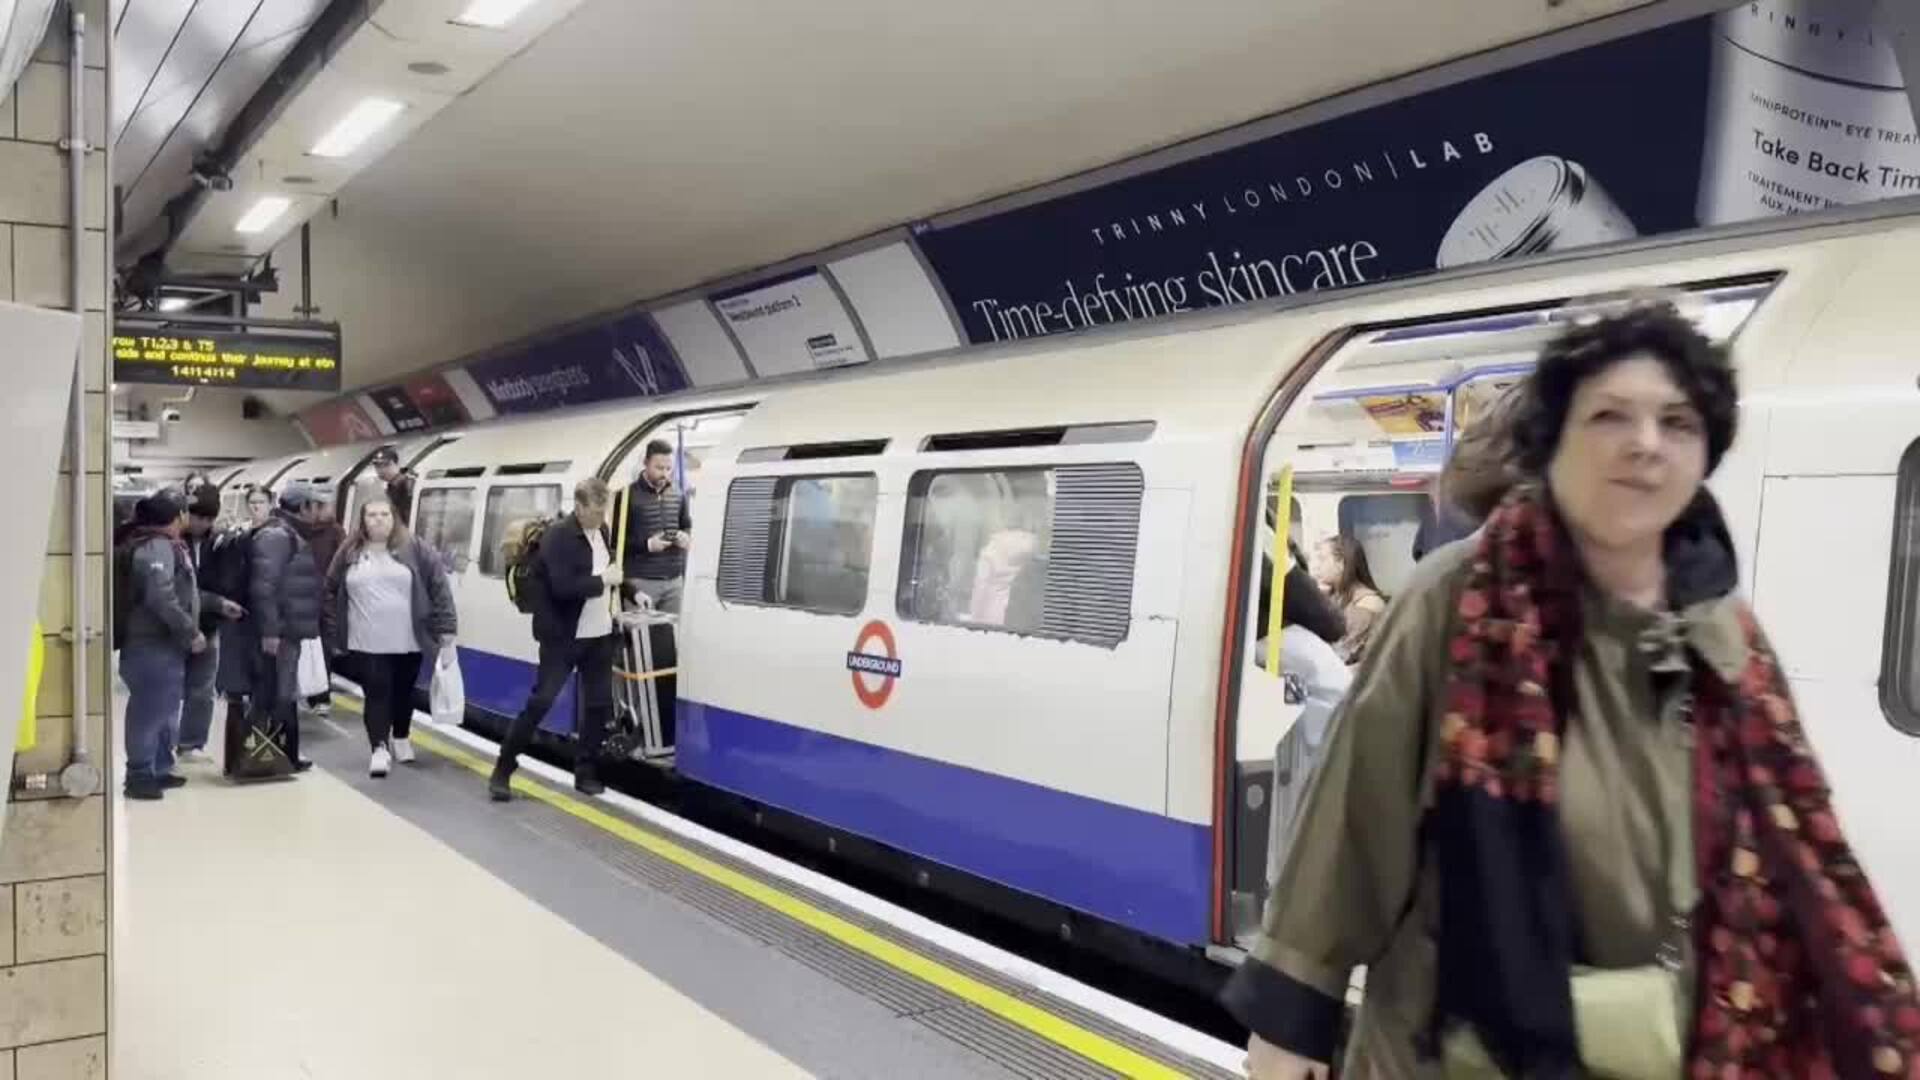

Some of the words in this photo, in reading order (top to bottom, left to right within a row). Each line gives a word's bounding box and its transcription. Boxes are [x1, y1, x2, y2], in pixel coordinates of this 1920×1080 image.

[1846, 124, 1873, 139] EYE
[1753, 129, 1799, 165] Take
[1808, 151, 1869, 184] Back
[1091, 203, 1208, 245] TRINNY
[1223, 161, 1373, 213] LONDON
[1409, 132, 1494, 169] LAB
[144, 350, 165, 360] and
[171, 365, 235, 379] 14:14:14
[848, 655, 900, 674] UNDERGROUND
